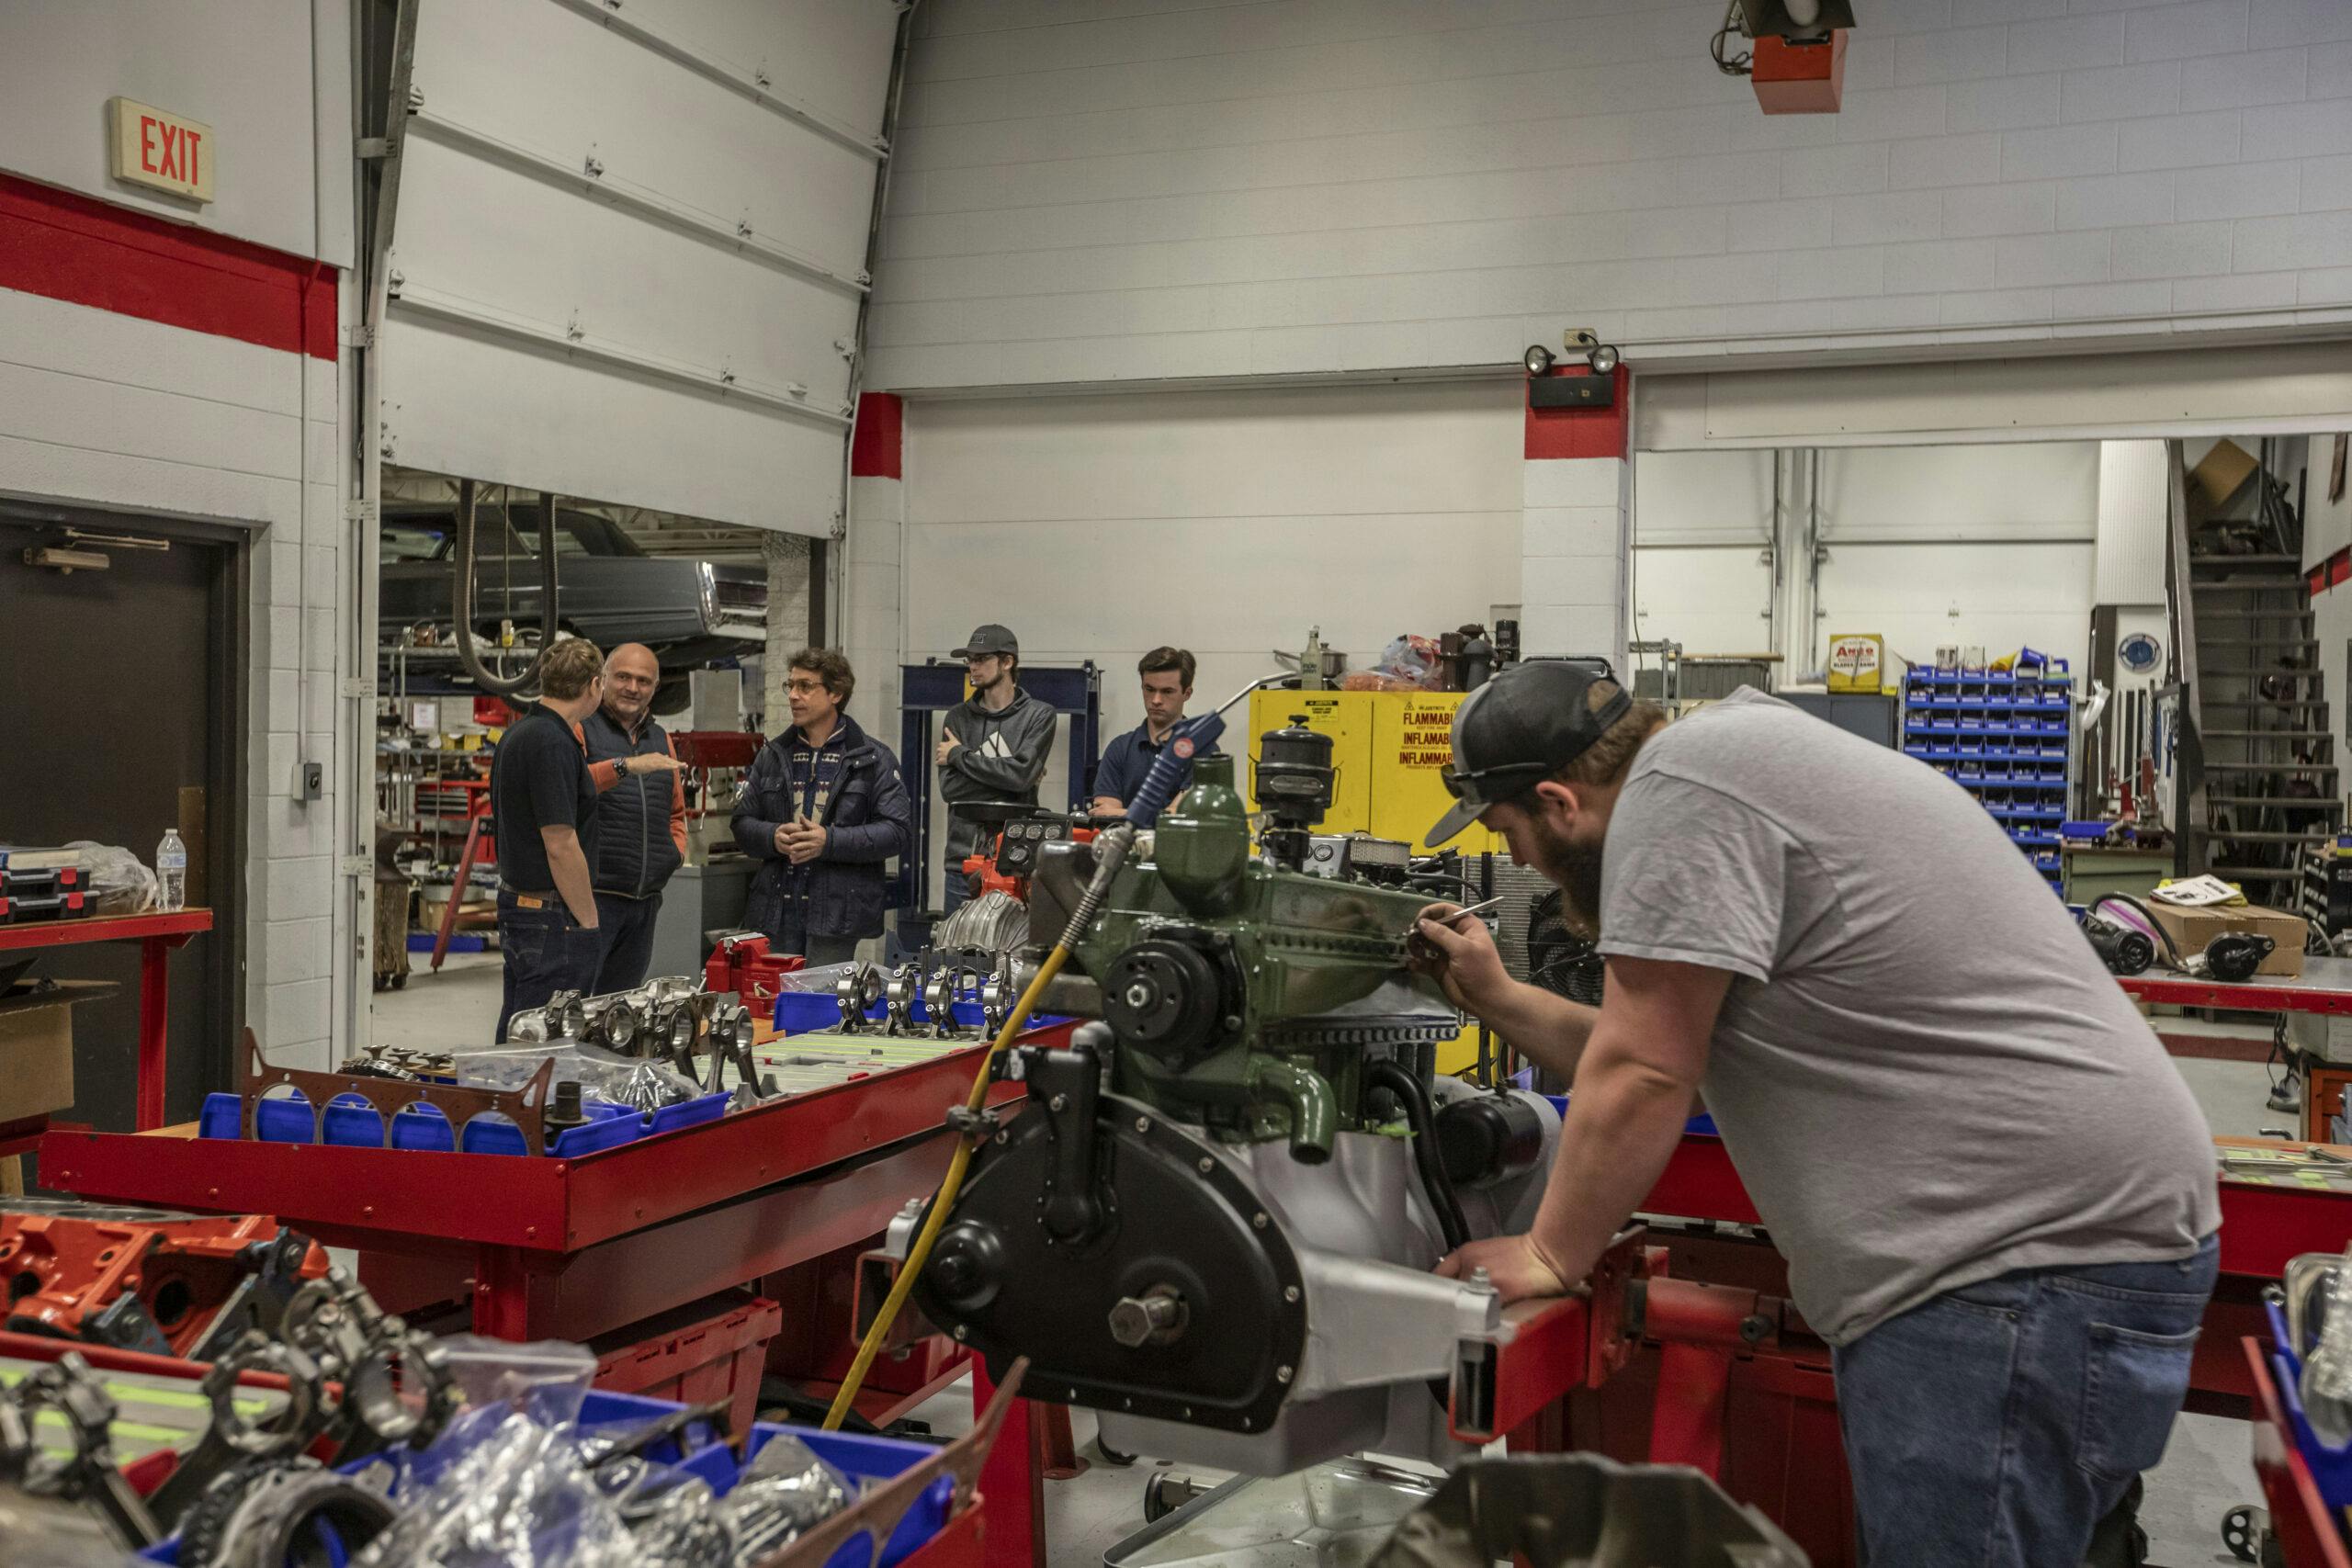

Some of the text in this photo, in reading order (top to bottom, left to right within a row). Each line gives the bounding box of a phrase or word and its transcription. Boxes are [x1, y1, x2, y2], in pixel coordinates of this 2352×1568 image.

[141, 116, 201, 186] EXIT
[1403, 712, 1453, 725] FLAMMAB
[1403, 732, 1451, 745] INFLAMAB
[1399, 751, 1453, 765] INFLAMMAB
